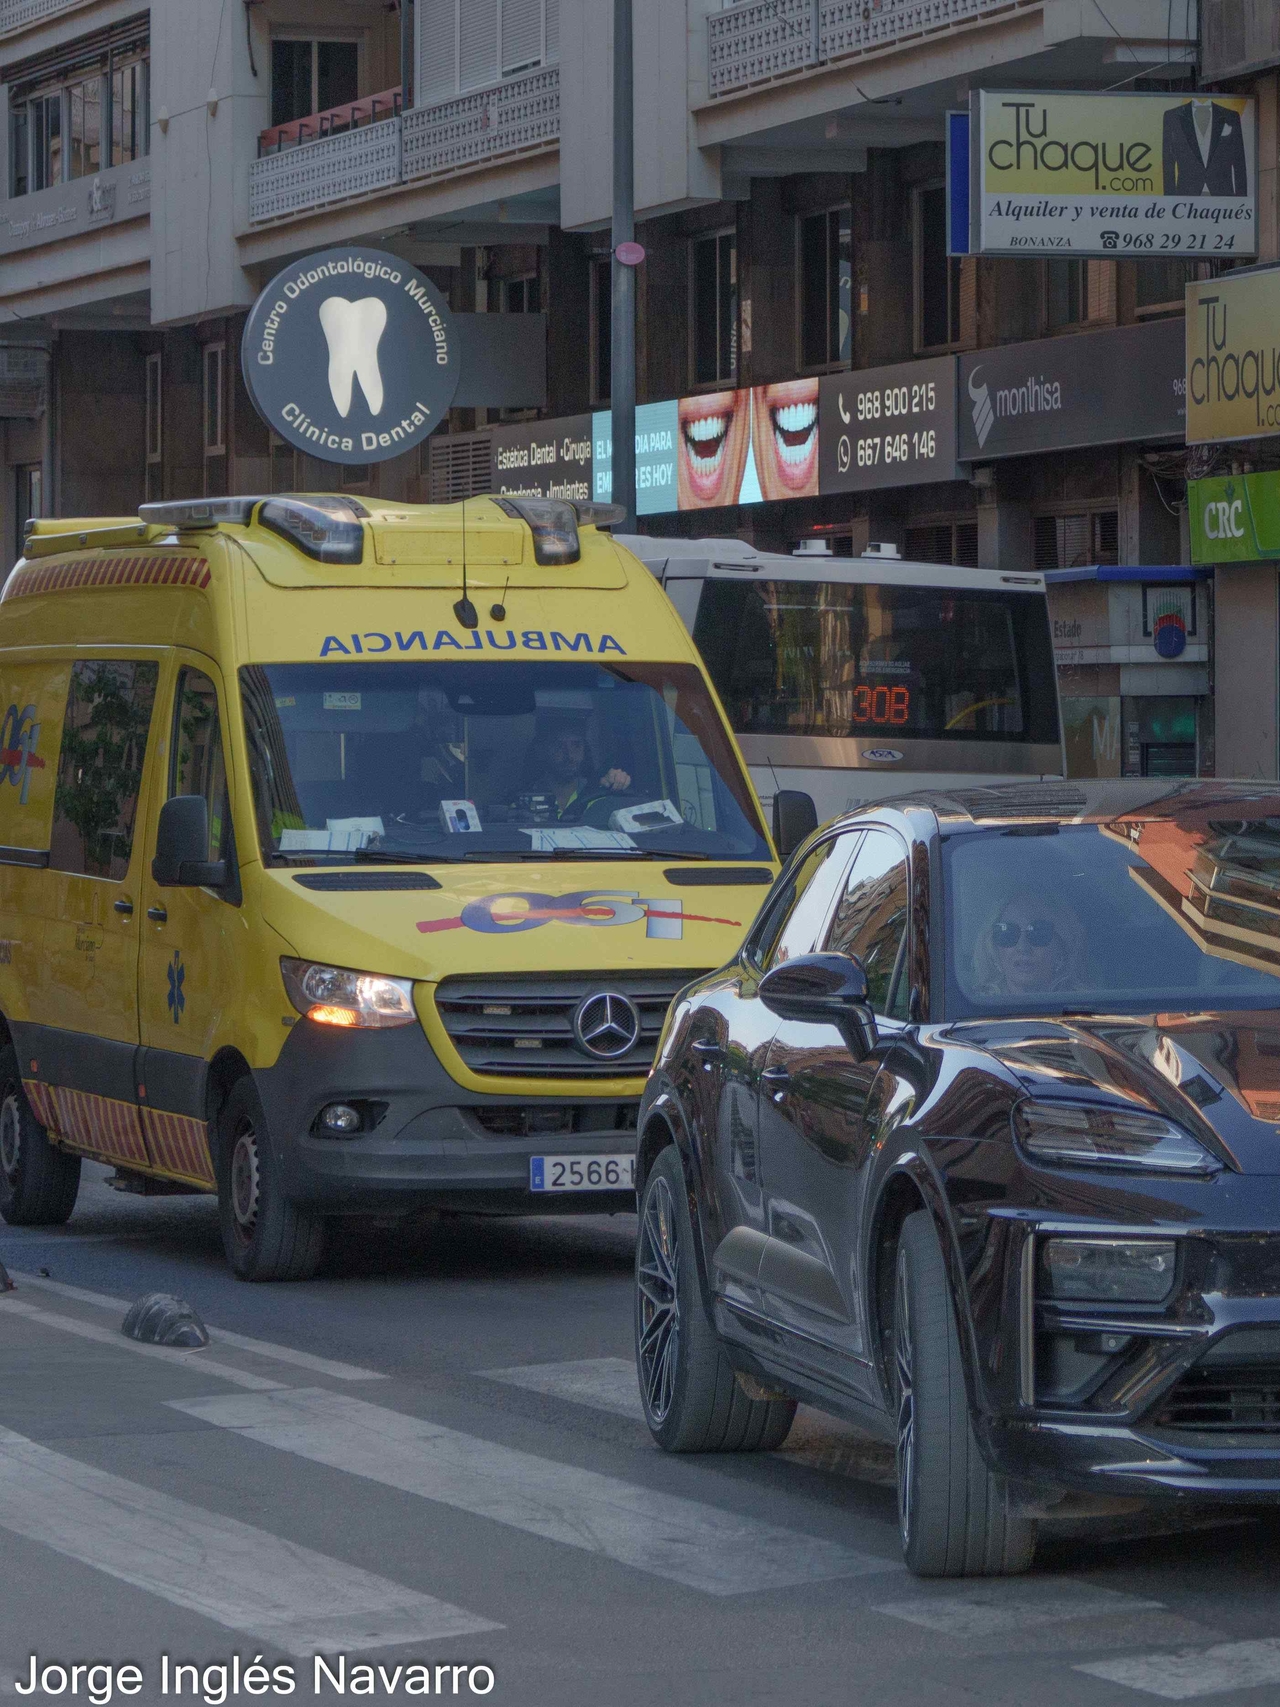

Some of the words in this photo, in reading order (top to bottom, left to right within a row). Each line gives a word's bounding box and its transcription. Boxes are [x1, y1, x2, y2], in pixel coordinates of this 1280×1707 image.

[1002, 102, 1047, 139] Tu
[988, 138, 1153, 191] chaque
[1101, 176, 1154, 192] .com
[989, 200, 1068, 222] Alquiler
[1072, 204, 1083, 222] y
[1090, 202, 1139, 219] venta
[1145, 201, 1166, 220] de
[1172, 201, 1252, 224] Chaqués
[1010, 236, 1072, 248] BONANZA
[1122, 233, 1155, 250] 968
[1159, 234, 1181, 250] 29
[1187, 234, 1208, 250] 21
[1212, 234, 1236, 250] 24
[258, 301, 287, 366] Centro
[283, 256, 402, 300] Odontológico
[404, 278, 448, 366] Murciano
[1198, 296, 1227, 352] Tu
[857, 391, 880, 421] 968
[884, 387, 909, 417] 900
[912, 382, 936, 413] 215
[996, 376, 1062, 418] monthisa
[281, 402, 353, 452] Clínica
[361, 401, 431, 451] Dental
[497, 444, 529, 470] Estética
[530, 440, 556, 466] Dental
[596, 441, 606, 460] EL
[650, 431, 673, 452] PARA
[857, 438, 880, 467] 667
[884, 434, 909, 464] 646
[912, 430, 936, 460] 146
[640, 466, 651, 488] ES
[653, 463, 673, 487] HOY
[1204, 500, 1245, 540] CRC
[535, 1176, 541, 1184] E
[551, 1160, 620, 1187] 2566
